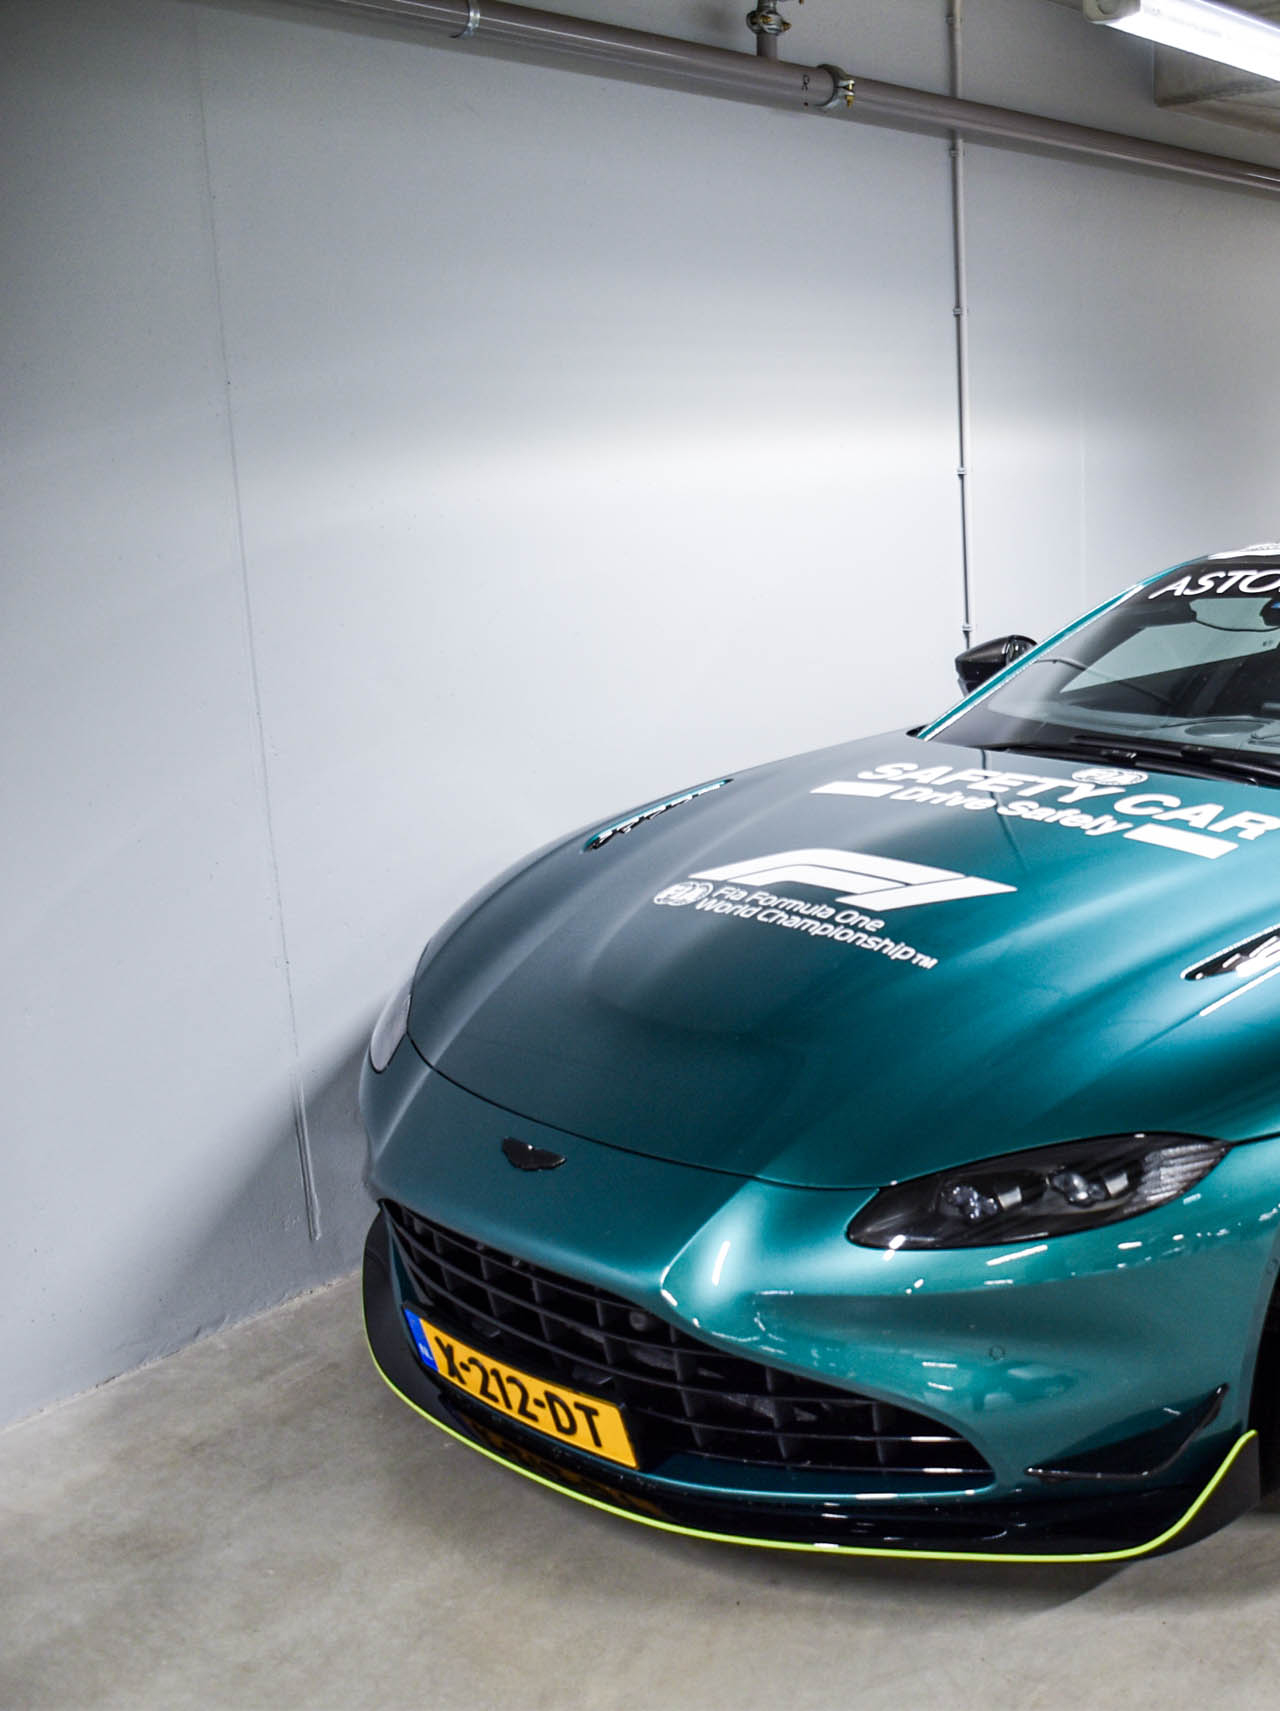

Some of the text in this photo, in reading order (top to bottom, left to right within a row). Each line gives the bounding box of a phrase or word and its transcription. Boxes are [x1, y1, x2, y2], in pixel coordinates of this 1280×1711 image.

[857, 762, 1126, 804] SAFETY
[890, 786, 1133, 836] Drive Safely
[695, 899, 759, 919] World
[745, 891, 836, 920] Formula
[834, 910, 886, 932] One
[433, 1336, 603, 1448] X-212-DT
